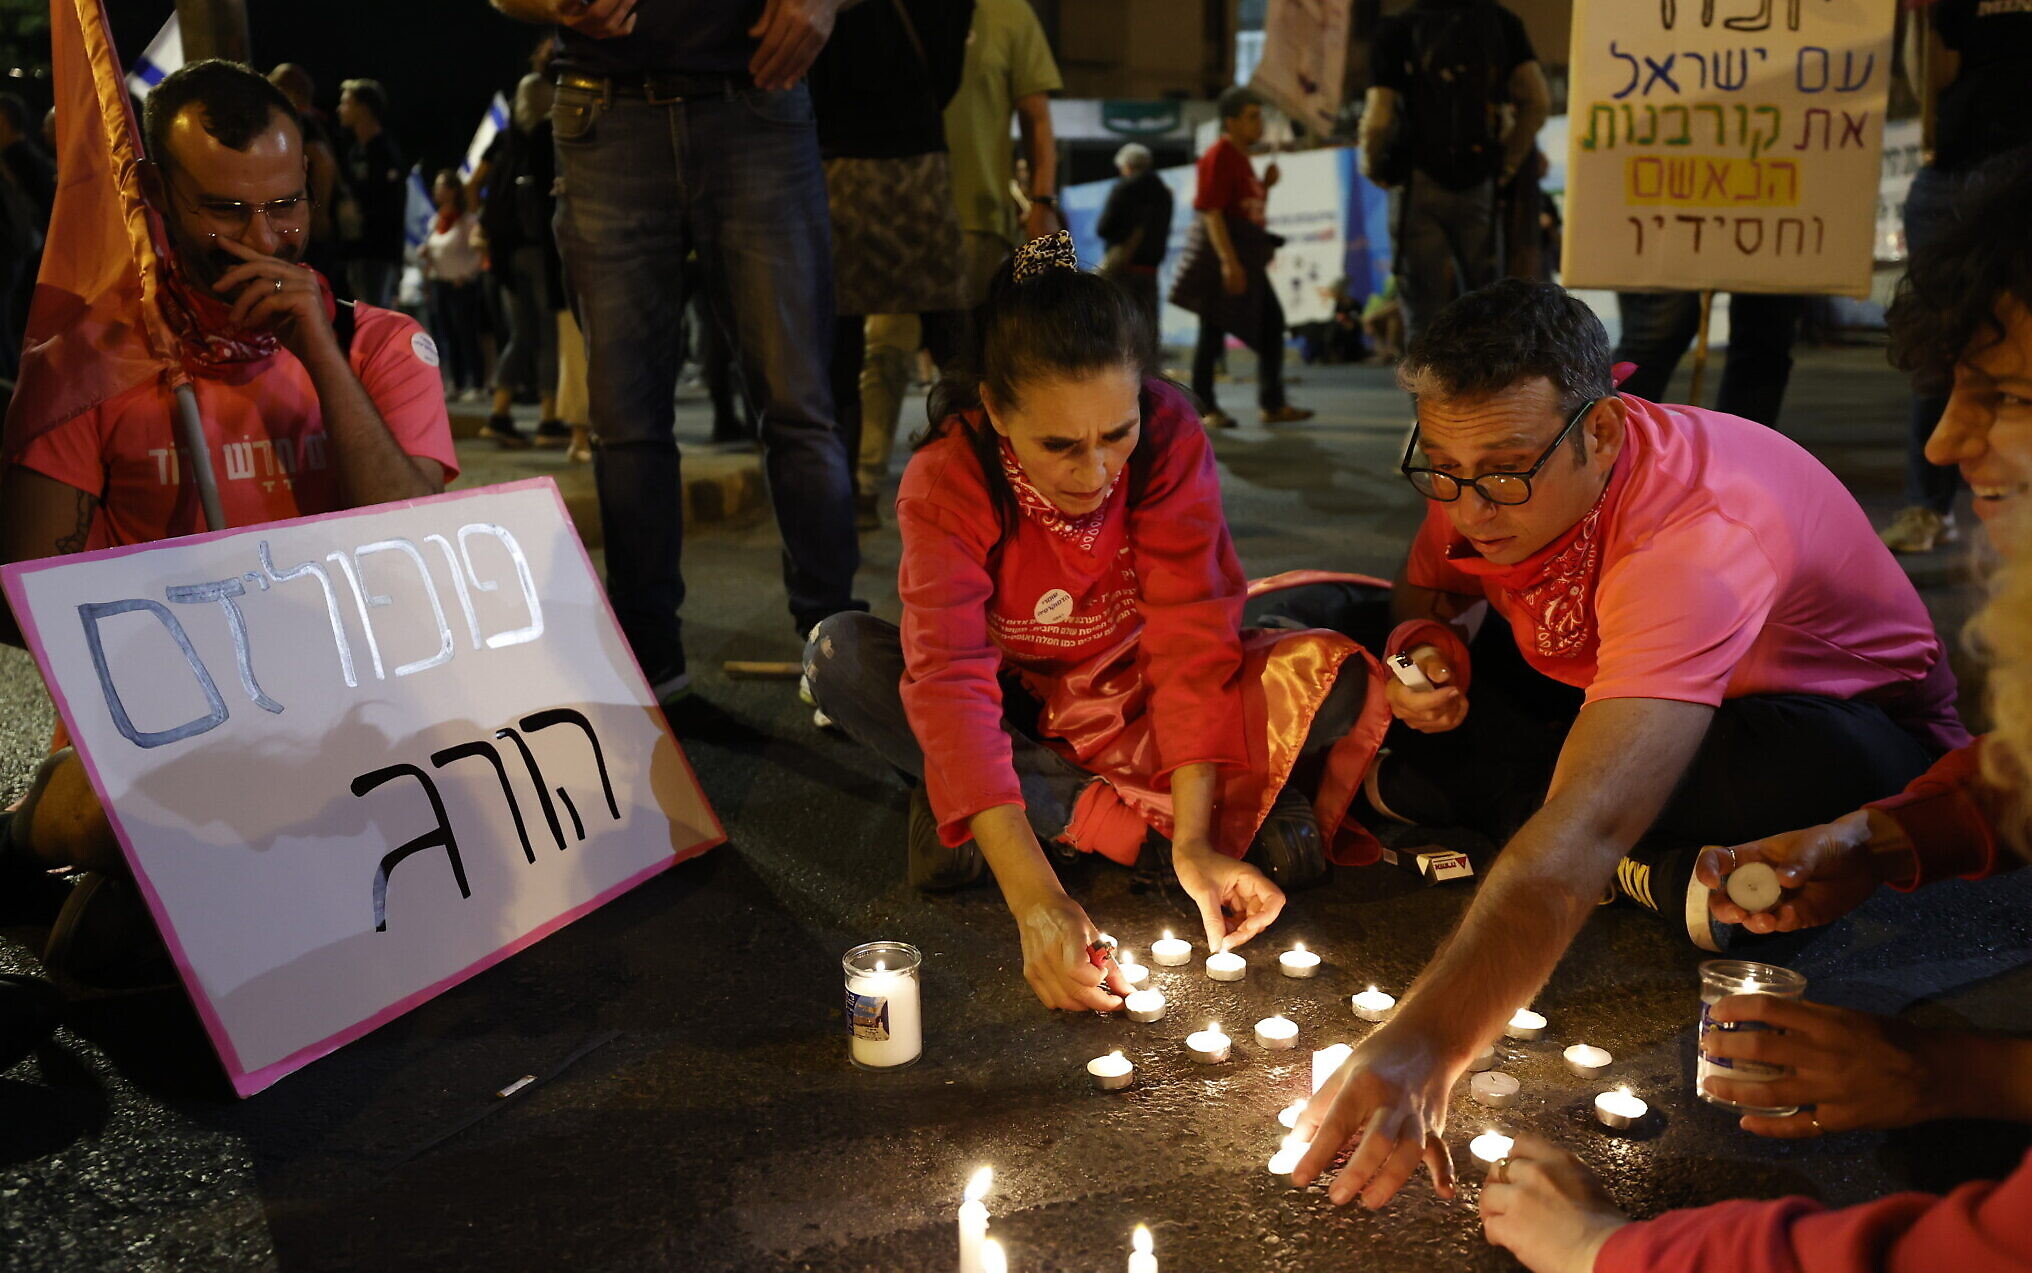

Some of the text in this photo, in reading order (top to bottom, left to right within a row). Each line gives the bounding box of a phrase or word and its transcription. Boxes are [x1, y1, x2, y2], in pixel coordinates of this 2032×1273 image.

[1610, 40, 1875, 99] עם ישראל
[1580, 103, 1869, 160] את קורבנות
[1627, 215, 1824, 257] וחסידיו
[77, 522, 545, 749] פופוליזם
[350, 707, 621, 933] הורג
